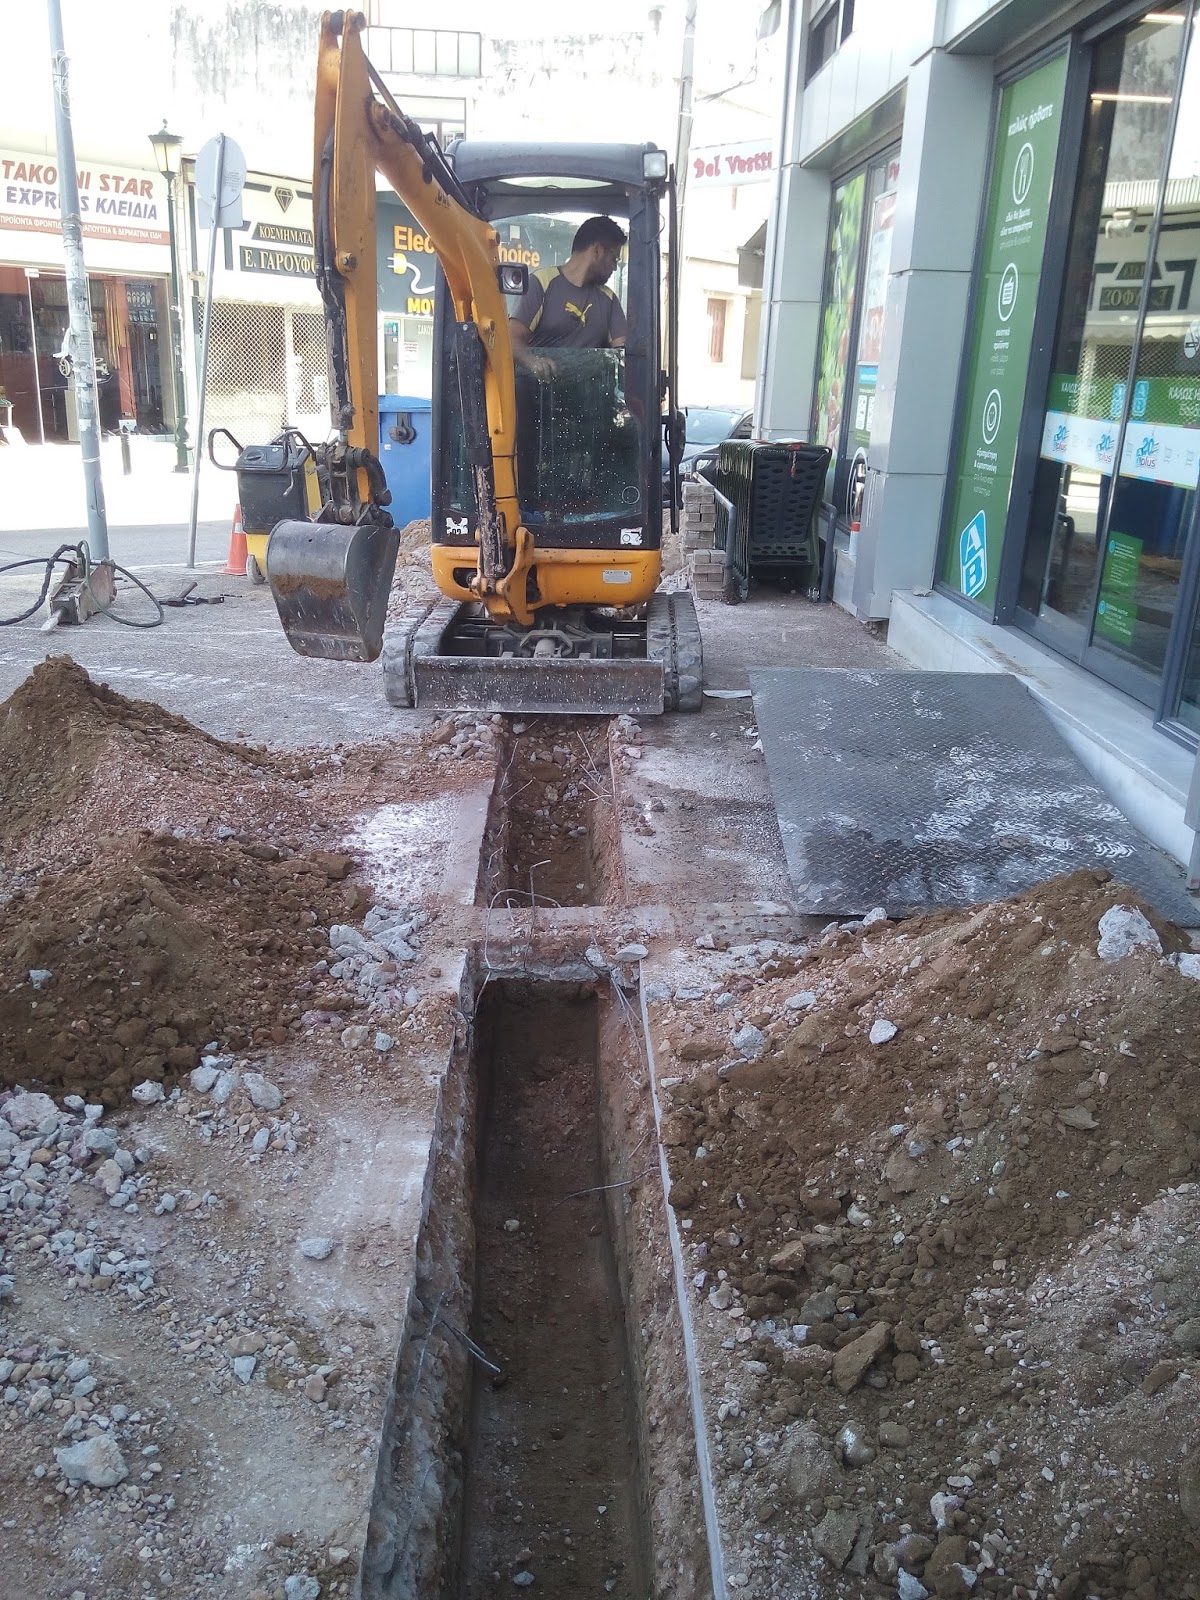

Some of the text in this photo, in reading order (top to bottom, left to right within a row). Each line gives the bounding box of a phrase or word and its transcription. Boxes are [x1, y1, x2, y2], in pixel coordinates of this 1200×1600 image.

[2, 160, 154, 199] ΤΑΚΟΝΙ STAR
[6, 186, 158, 220] EXPRS ΚΛΕΙΔΙΑ
[259, 225, 313, 244] ΚΟΣΜΗΜΑΤΑ
[394, 225, 541, 267] Elec hoice
